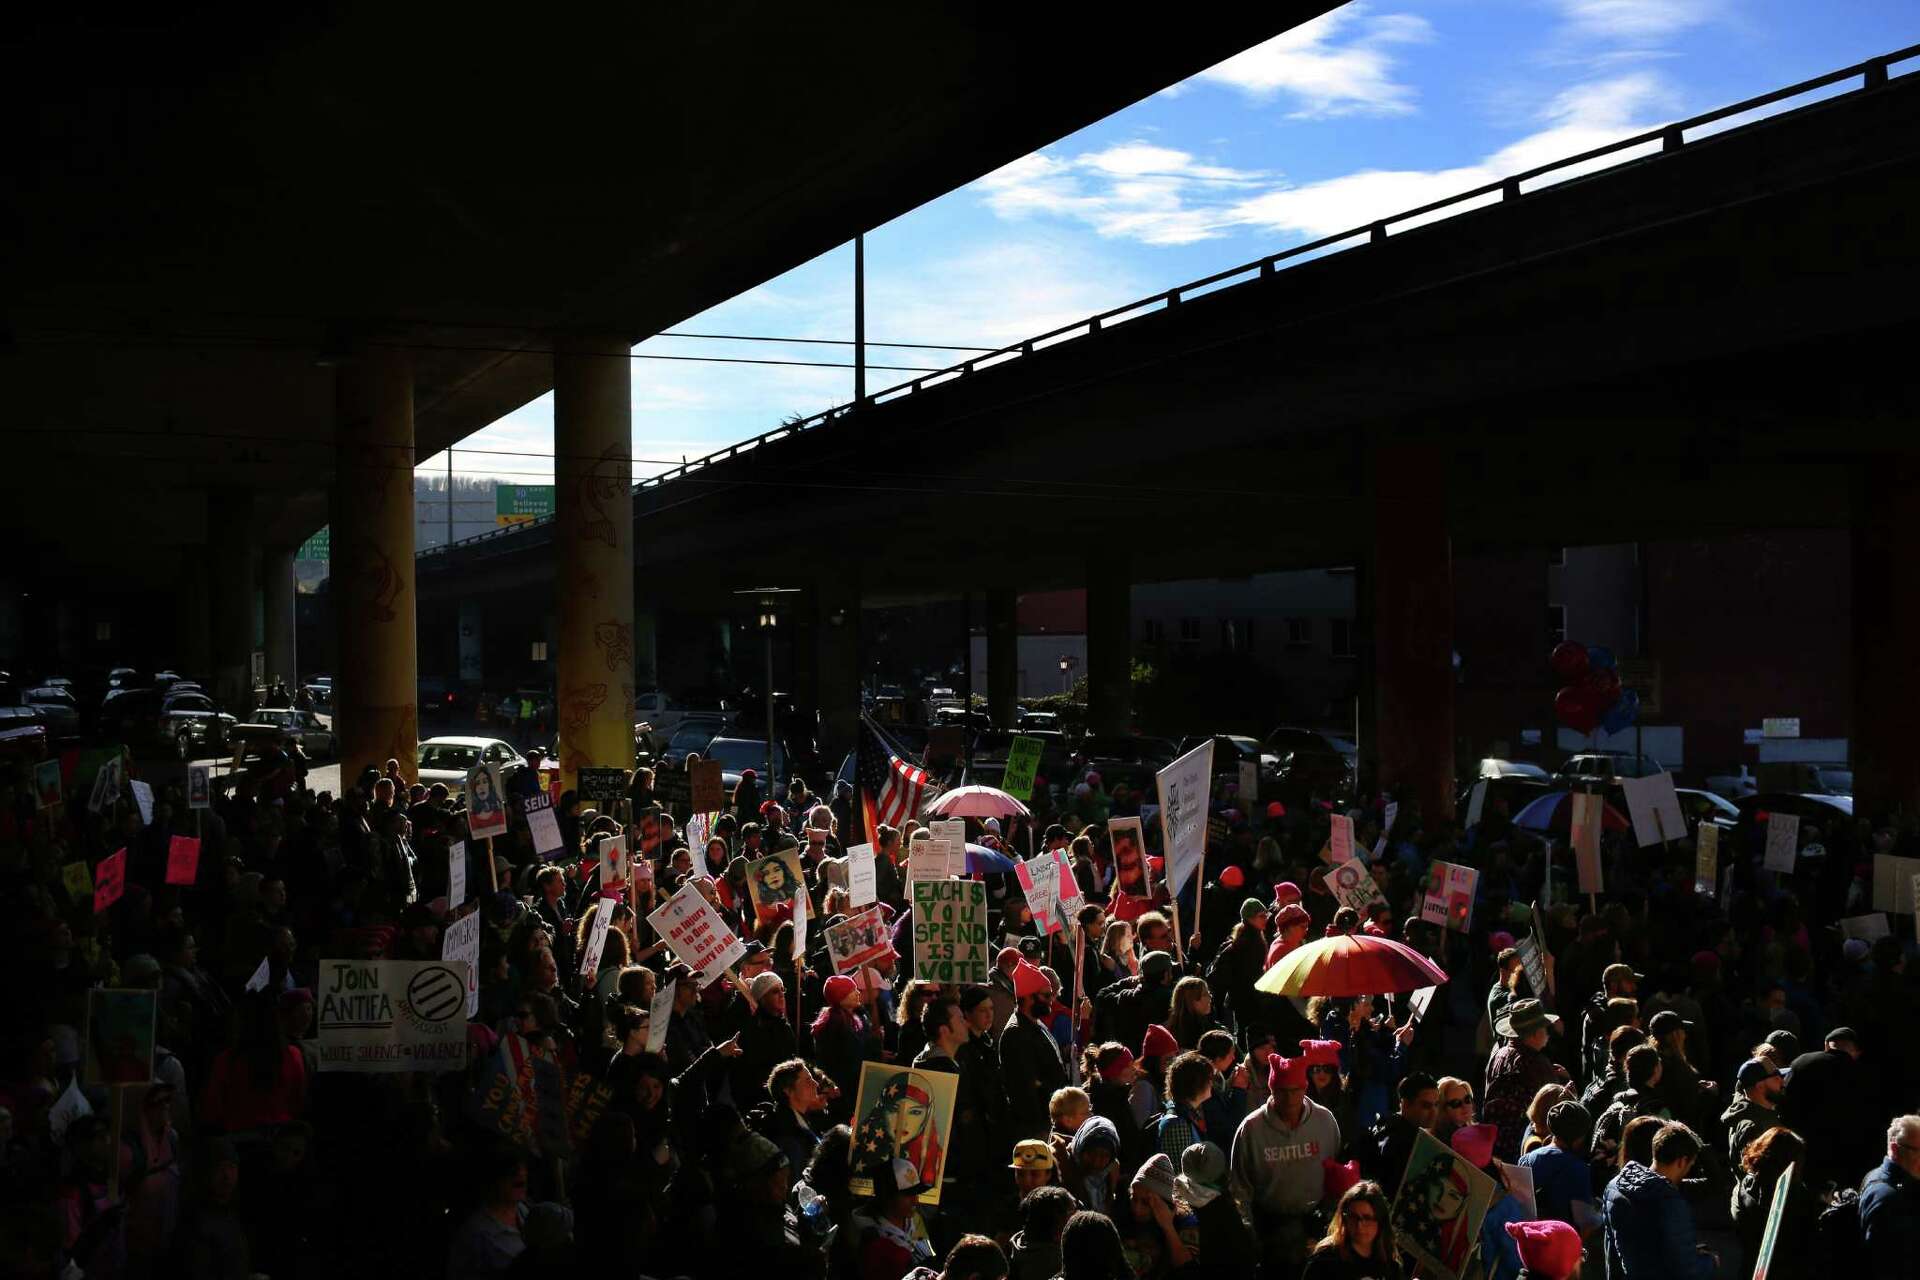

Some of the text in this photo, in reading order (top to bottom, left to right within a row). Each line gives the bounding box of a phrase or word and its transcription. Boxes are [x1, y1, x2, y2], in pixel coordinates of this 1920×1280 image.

[524, 794, 550, 812] SEIU
[914, 881, 984, 905] EACH $
[920, 902, 975, 922] YOU
[670, 907, 707, 940] An Injury
[915, 923, 986, 944] SPEND
[683, 936, 695, 945] to
[694, 934, 716, 953] is an
[714, 943, 726, 955] to
[722, 933, 736, 946] All
[928, 944, 980, 960] IS A
[330, 964, 379, 993] JOIN
[919, 960, 985, 982] VOTE
[320, 993, 393, 1022] ANTIFA
[320, 1045, 353, 1060] WHITE
[359, 1042, 402, 1058] SILENCE
[415, 1041, 465, 1060] VIOLENCE
